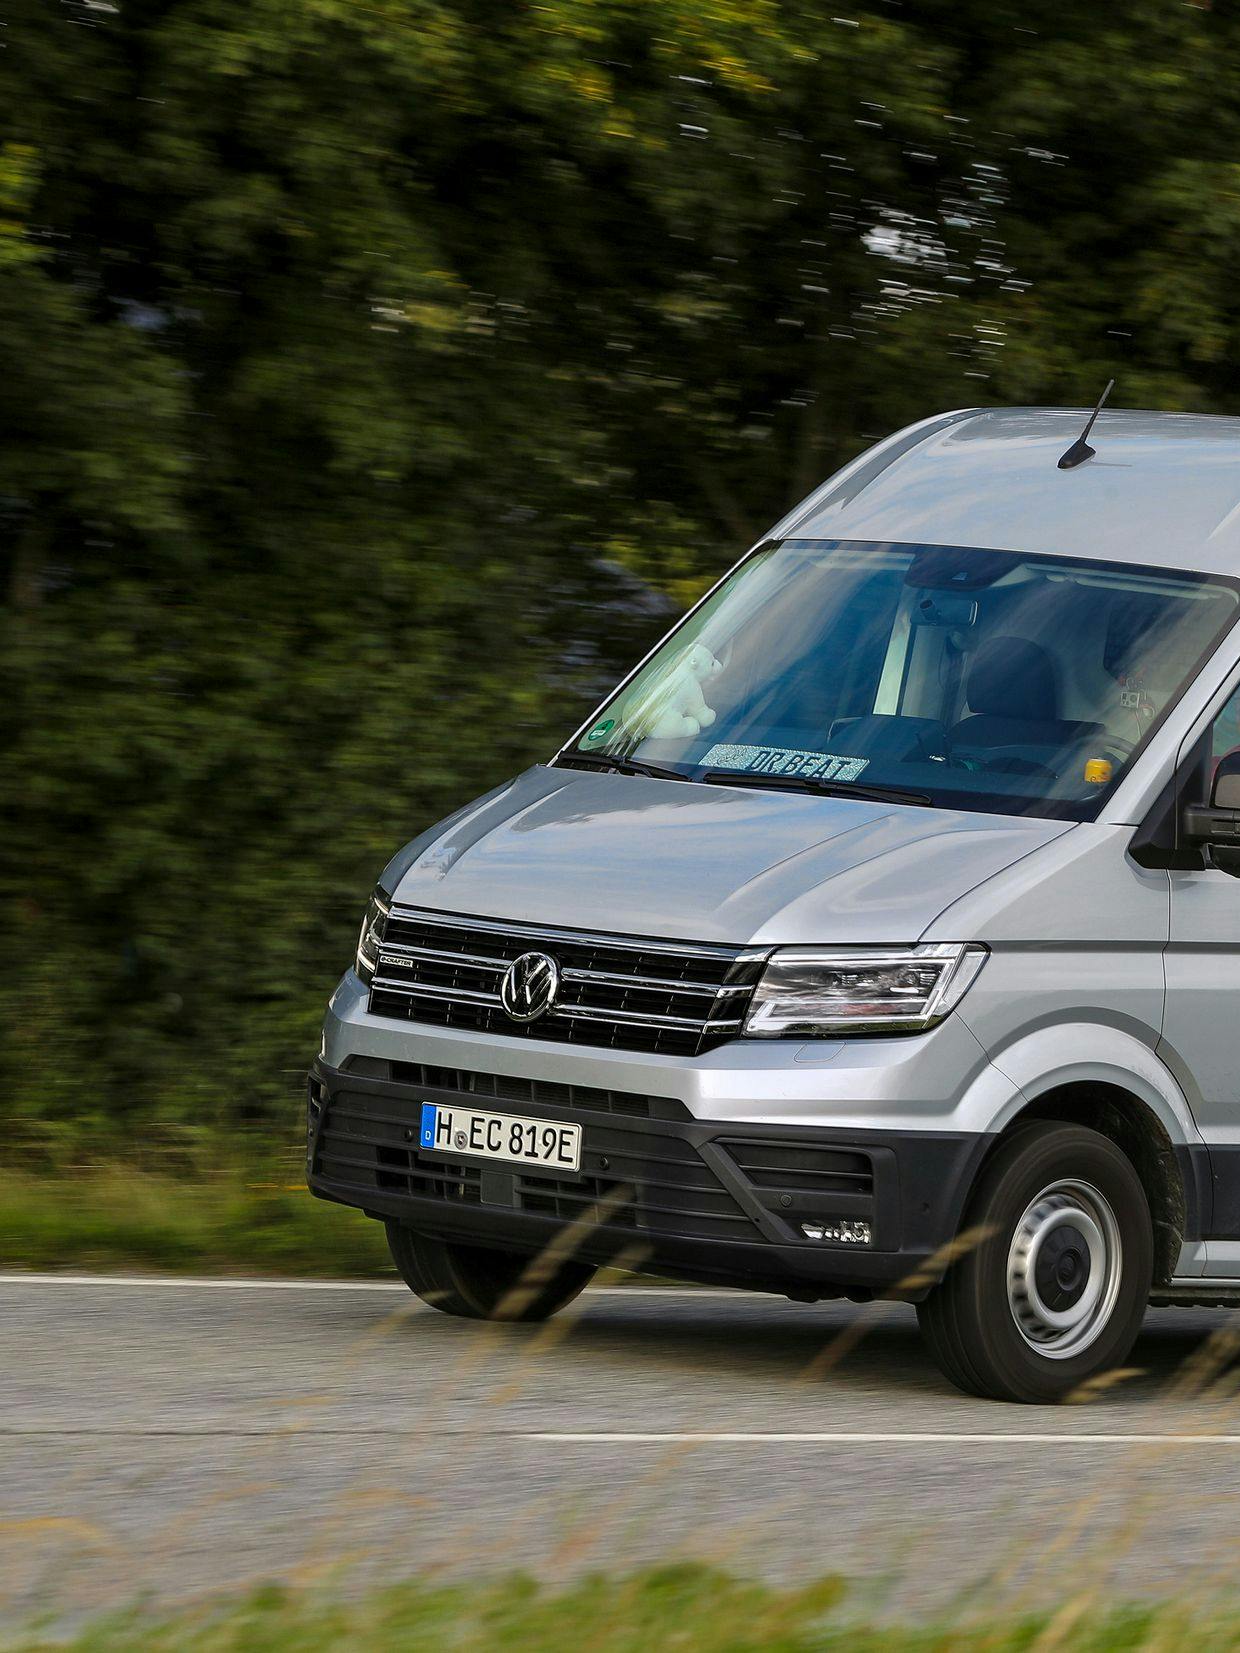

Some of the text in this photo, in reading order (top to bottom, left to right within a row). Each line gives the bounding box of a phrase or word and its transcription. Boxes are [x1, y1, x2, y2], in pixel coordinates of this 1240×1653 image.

[425, 1111, 574, 1163] D H EC 819E
